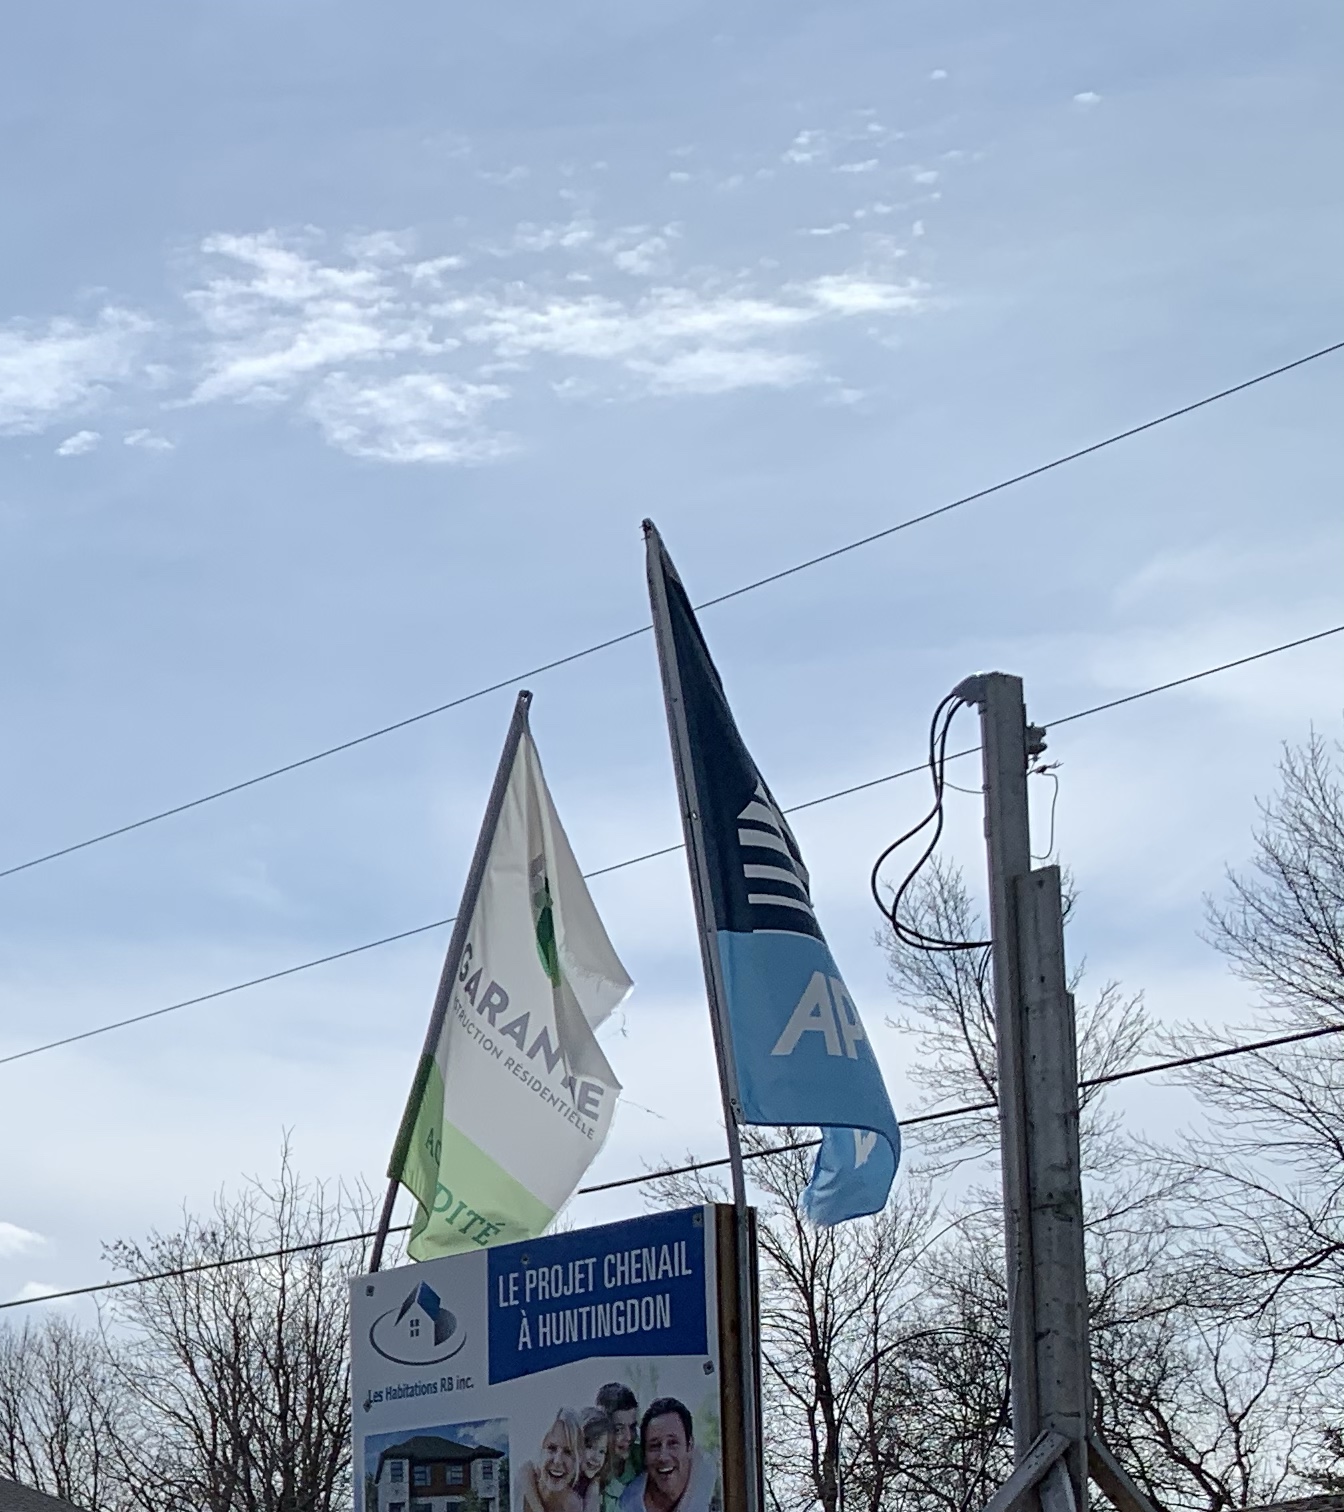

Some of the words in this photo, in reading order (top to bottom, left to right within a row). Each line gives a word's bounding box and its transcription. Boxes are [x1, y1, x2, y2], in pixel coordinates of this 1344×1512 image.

[504, 1056, 595, 1140] RÉSIDENTIELLE
[498, 1272, 520, 1308] LE
[525, 1257, 597, 1304] PROJET
[603, 1240, 693, 1290] CHENAIL
[518, 1308, 532, 1351] À
[538, 1293, 672, 1348] HUNTINGDON
[367, 1389, 384, 1404] Les
[385, 1380, 438, 1402] Habitations
[439, 1376, 454, 1393] RB
[455, 1374, 474, 1391] inc.
